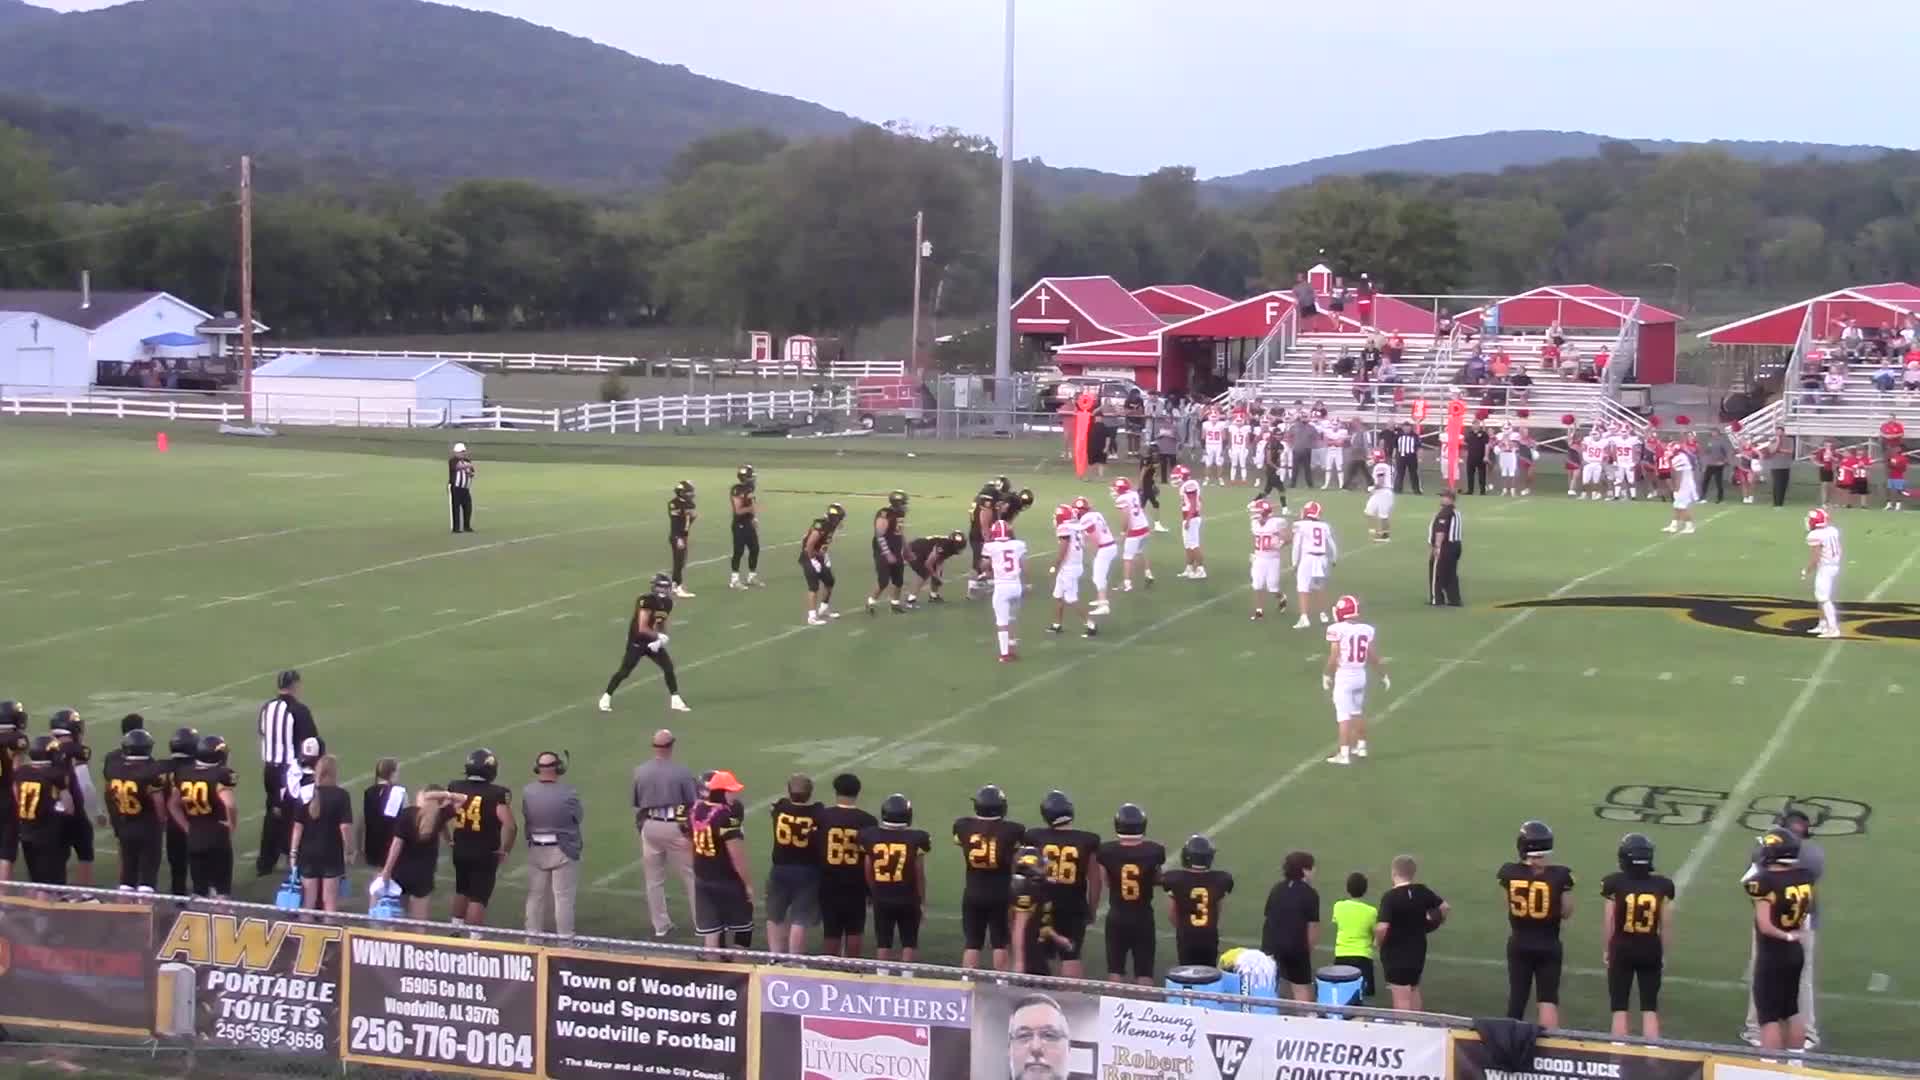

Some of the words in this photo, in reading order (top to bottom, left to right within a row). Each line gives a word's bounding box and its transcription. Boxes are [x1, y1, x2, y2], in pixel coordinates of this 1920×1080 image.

[1312, 527, 1323, 547] 9
[1003, 549, 1015, 572] 5
[1347, 634, 1369, 663] 16
[18, 781, 41, 819] 17
[776, 812, 814, 848] 63
[826, 827, 860, 865] 65
[873, 843, 907, 882] 27
[968, 833, 998, 869] 21
[1120, 863, 1140, 901] 6
[1190, 887, 1209, 927] 3
[1509, 879, 1551, 920] 50
[1623, 893, 1657, 933] 13
[155, 910, 344, 977] AWT
[352, 938, 402, 969] WWW
[404, 945, 500, 977] Restoration
[503, 954, 536, 983] INC.
[207, 970, 337, 1003] PORTABLE
[400, 976, 438, 996] 15905
[439, 980, 456, 997] Co
[457, 982, 474, 999] Rd
[559, 971, 611, 991] Town
[617, 976, 637, 993] of
[641, 977, 738, 1001] Woodville
[220, 997, 322, 1028] TOILETS
[384, 997, 448, 1021] Woodville,
[450, 1005, 465, 1021] AL
[465, 1005, 500, 1026] 35776
[557, 995, 616, 1016] Proud
[621, 1000, 712, 1024] Sponsors
[718, 1010, 738, 1027] of
[1114, 1003, 1133, 1020] In
[1137, 1007, 1193, 1031] Loving
[215, 1022, 325, 1050] 256-599-3658
[351, 1015, 534, 1069] 256-776-0164
[556, 1020, 651, 1044] Woodville
[656, 1029, 736, 1053] Football
[1112, 1020, 1176, 1046] Memory
[1180, 1029, 1197, 1048] of
[565, 1057, 583, 1067] The
[584, 1059, 612, 1070] Mayor
[614, 1062, 631, 1072] and
[645, 1065, 655, 1074] of
[656, 1066, 671, 1075] the
[673, 1067, 691, 1079] City
[805, 1047, 928, 1080] LIVINGSTON
[1112, 1045, 1194, 1073] Robert
[1275, 1039, 1405, 1069] WIREGRASS
[1533, 1057, 1575, 1073] GOOD
[1577, 1061, 1620, 1078] LUCK
